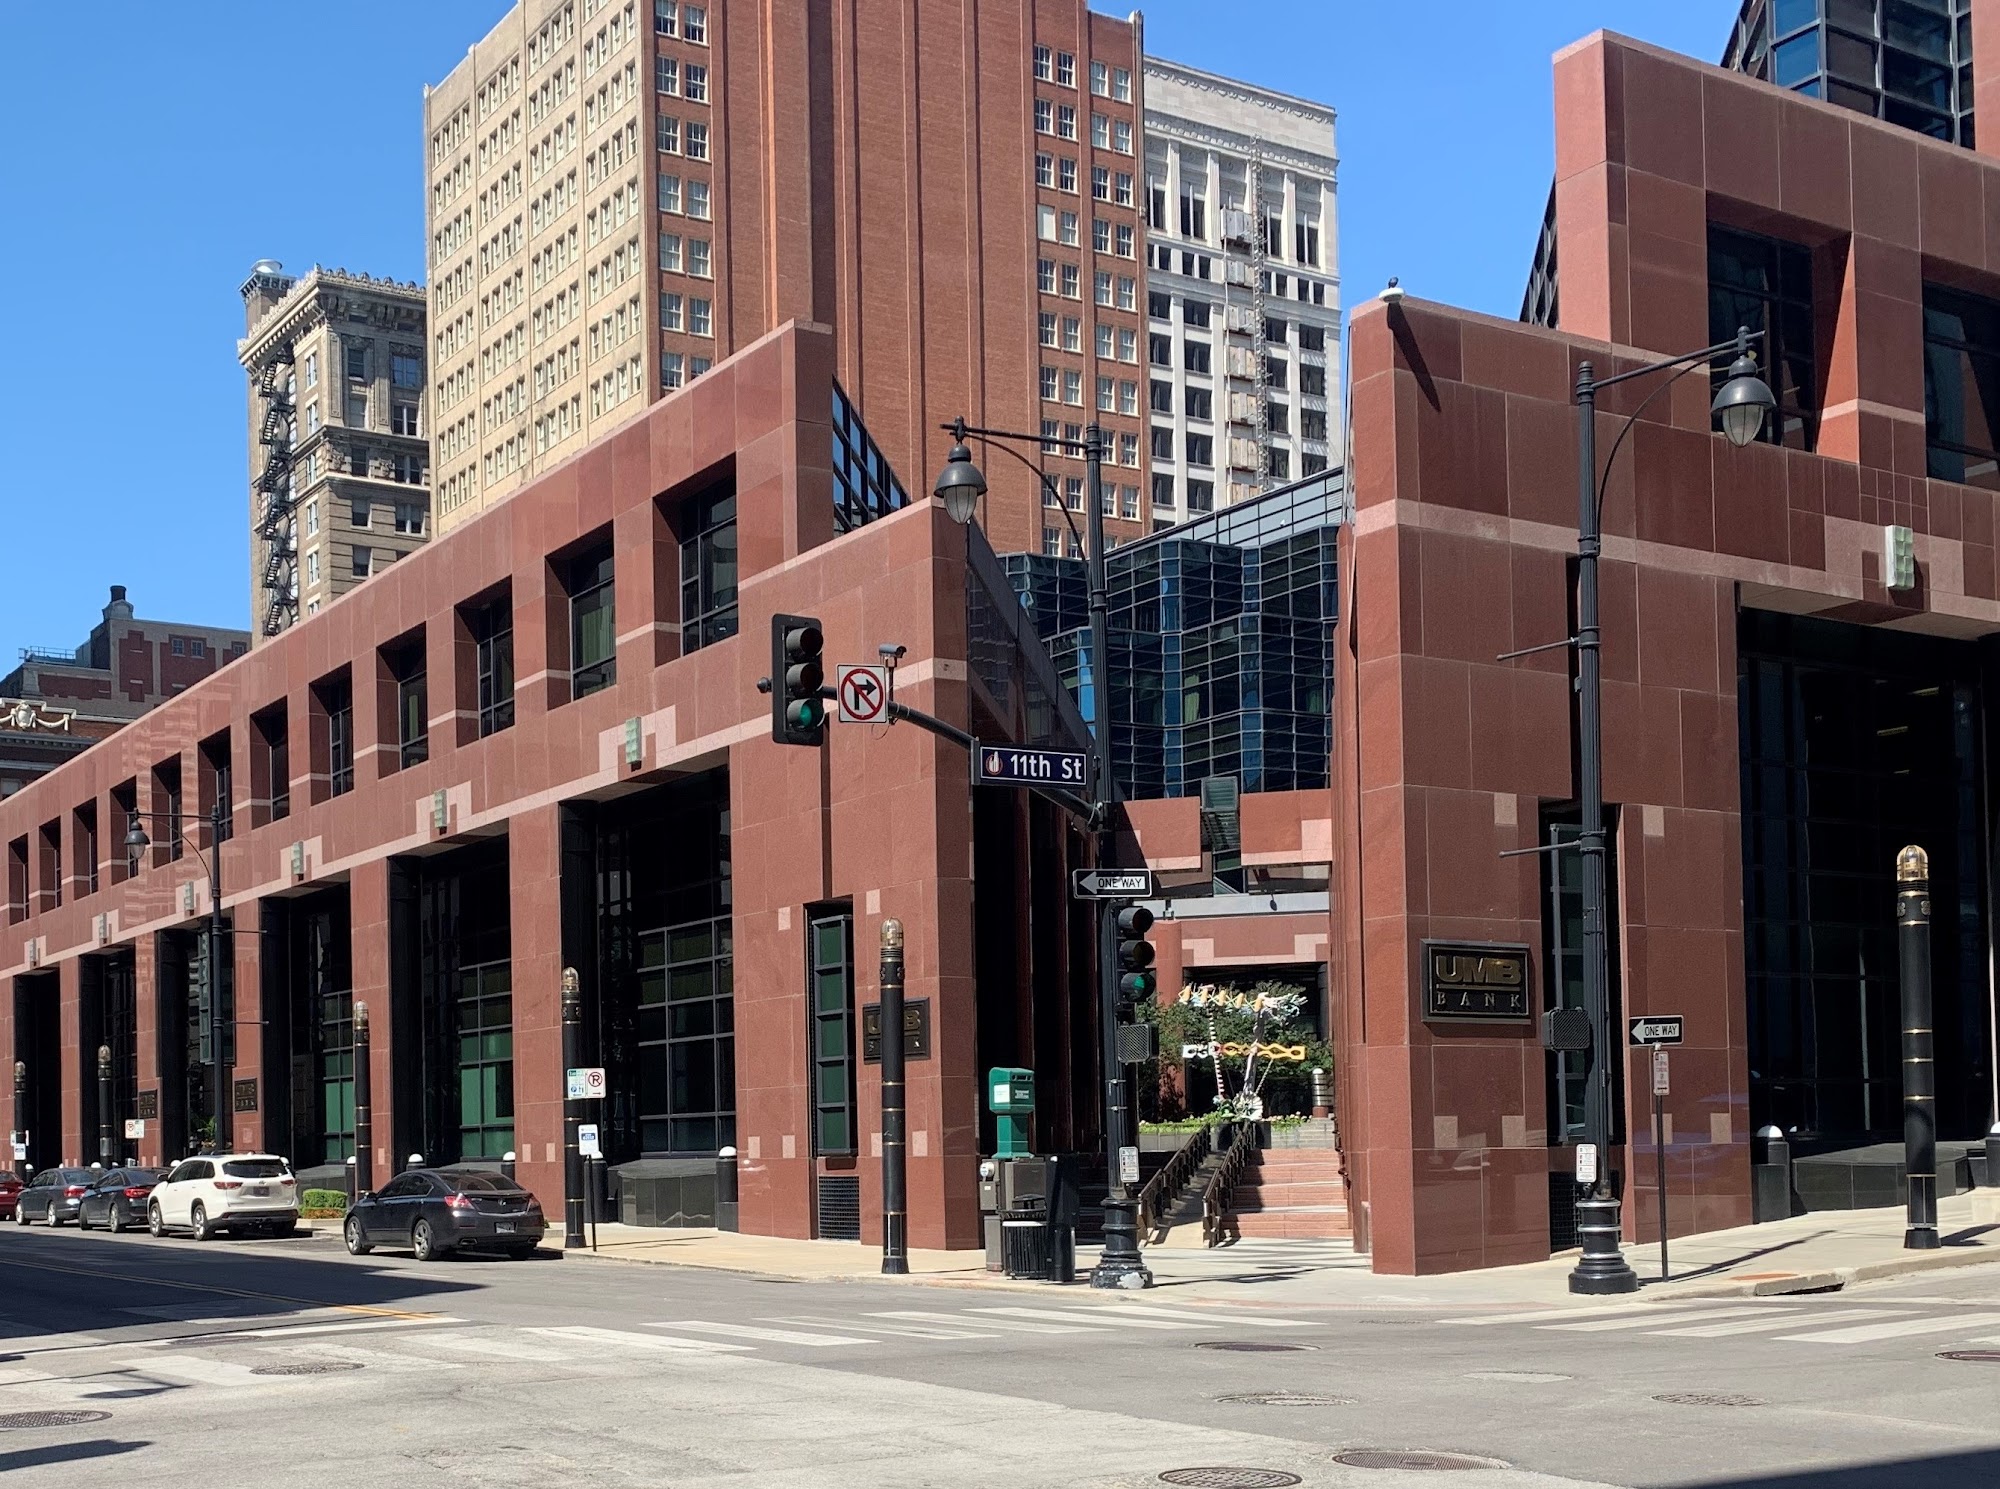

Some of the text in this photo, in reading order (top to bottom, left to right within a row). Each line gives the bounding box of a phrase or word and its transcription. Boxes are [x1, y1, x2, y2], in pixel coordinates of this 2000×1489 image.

[1010, 754, 1082, 780] 11th St
[1098, 878, 1142, 888] ONE WAY
[1435, 955, 1521, 985] UMB
[1436, 991, 1521, 1008] BANK
[867, 1009, 921, 1035] UB
[1644, 1024, 1678, 1037] ONE WAY
